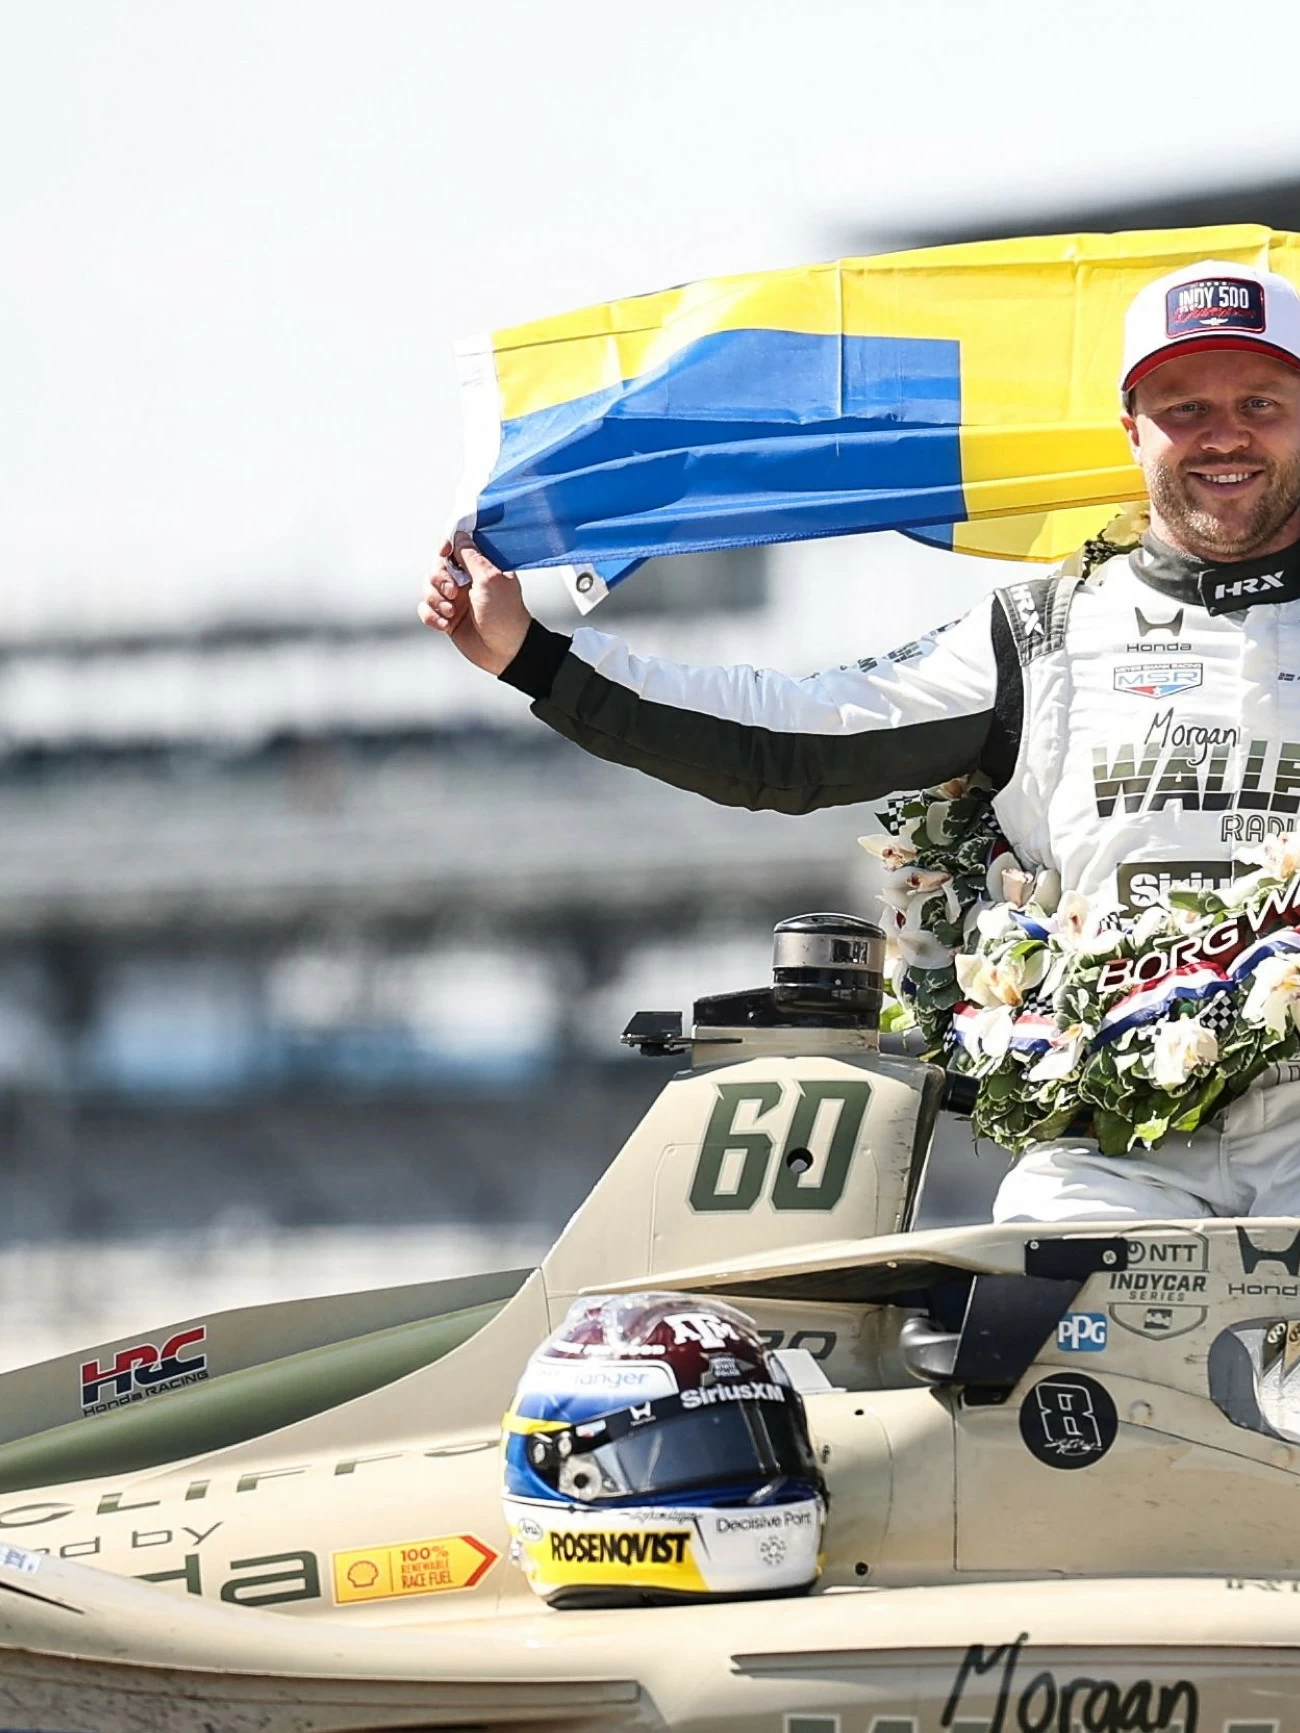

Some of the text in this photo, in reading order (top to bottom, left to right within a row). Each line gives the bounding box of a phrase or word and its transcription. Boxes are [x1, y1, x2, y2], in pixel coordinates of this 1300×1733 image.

[1179, 286, 1249, 309] INDY 500
[1215, 570, 1284, 600] HRX
[1010, 585, 1045, 636] HRX
[1127, 642, 1191, 652] Honda
[1118, 671, 1198, 686] MSR
[1144, 707, 1238, 766] Morgan
[1221, 814, 1294, 842] RADI
[687, 1078, 875, 1214] 60
[1150, 1244, 1197, 1262] NTT
[1110, 1273, 1206, 1292] INDYCAR
[1129, 1291, 1185, 1302] SERIES
[1057, 1316, 1106, 1349] PPG
[81, 1325, 206, 1407] HRC
[84, 1370, 209, 1417] Honda RACING
[681, 1381, 785, 1409] SiriusXM
[133, 1521, 224, 1548] by
[716, 1516, 782, 1533] Decisive
[400, 1545, 449, 1562] 100%
[550, 1530, 690, 1564] ROSENQVIST
[401, 1559, 449, 1575] RENEWABLE
[402, 1571, 453, 1589] RACE FUEL
[941, 1631, 1198, 1733] Morgan
